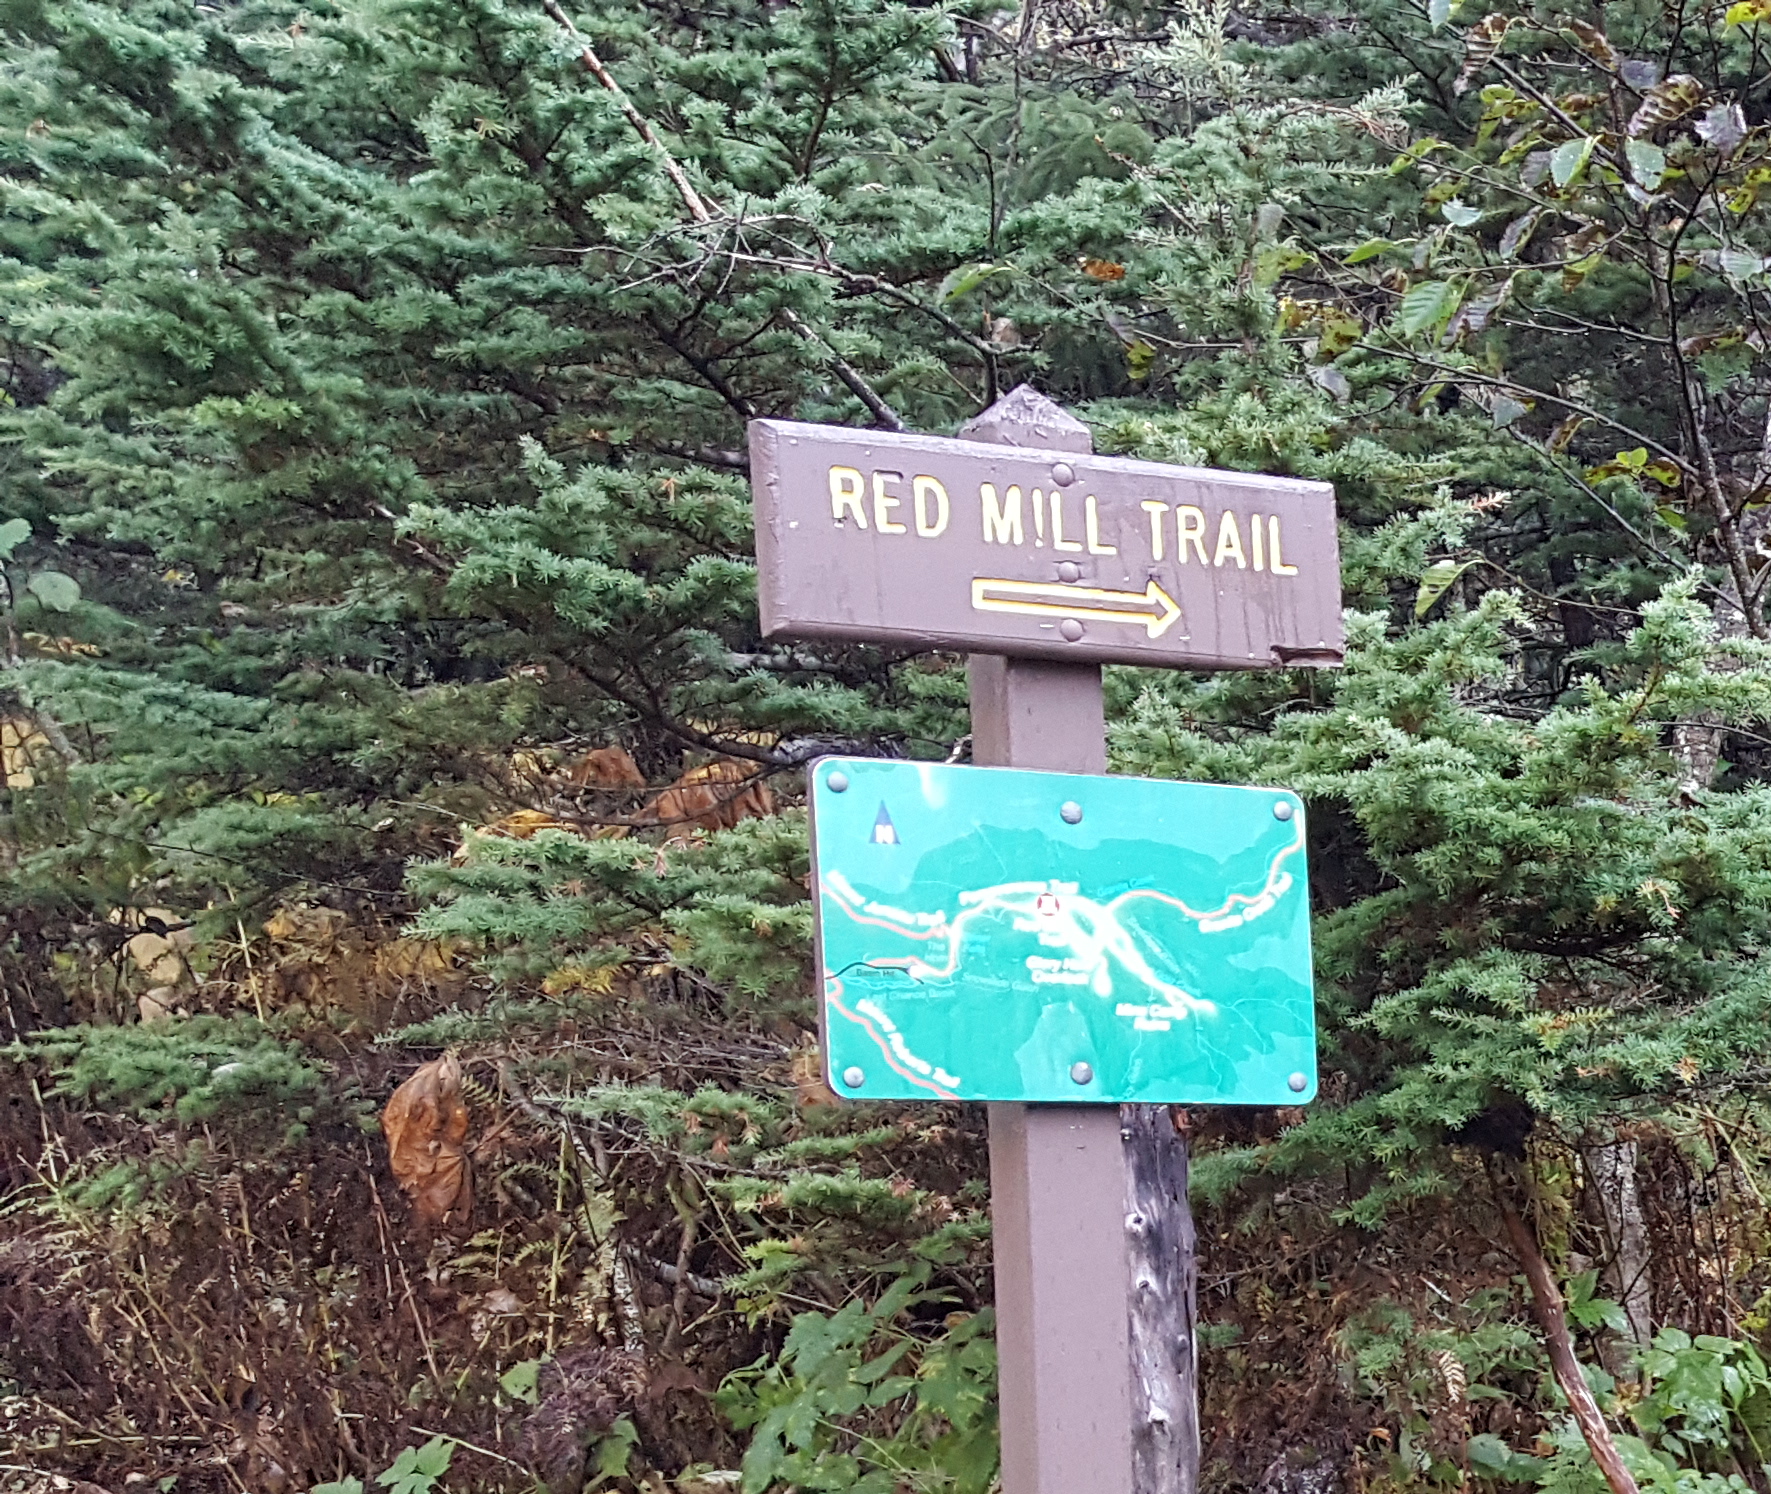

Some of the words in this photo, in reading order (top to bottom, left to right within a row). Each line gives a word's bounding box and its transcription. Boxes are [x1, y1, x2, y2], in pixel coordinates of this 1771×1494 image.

[828, 465, 951, 538] RED
[980, 482, 1118, 555] MILL
[1140, 499, 1299, 576] TRAIL
